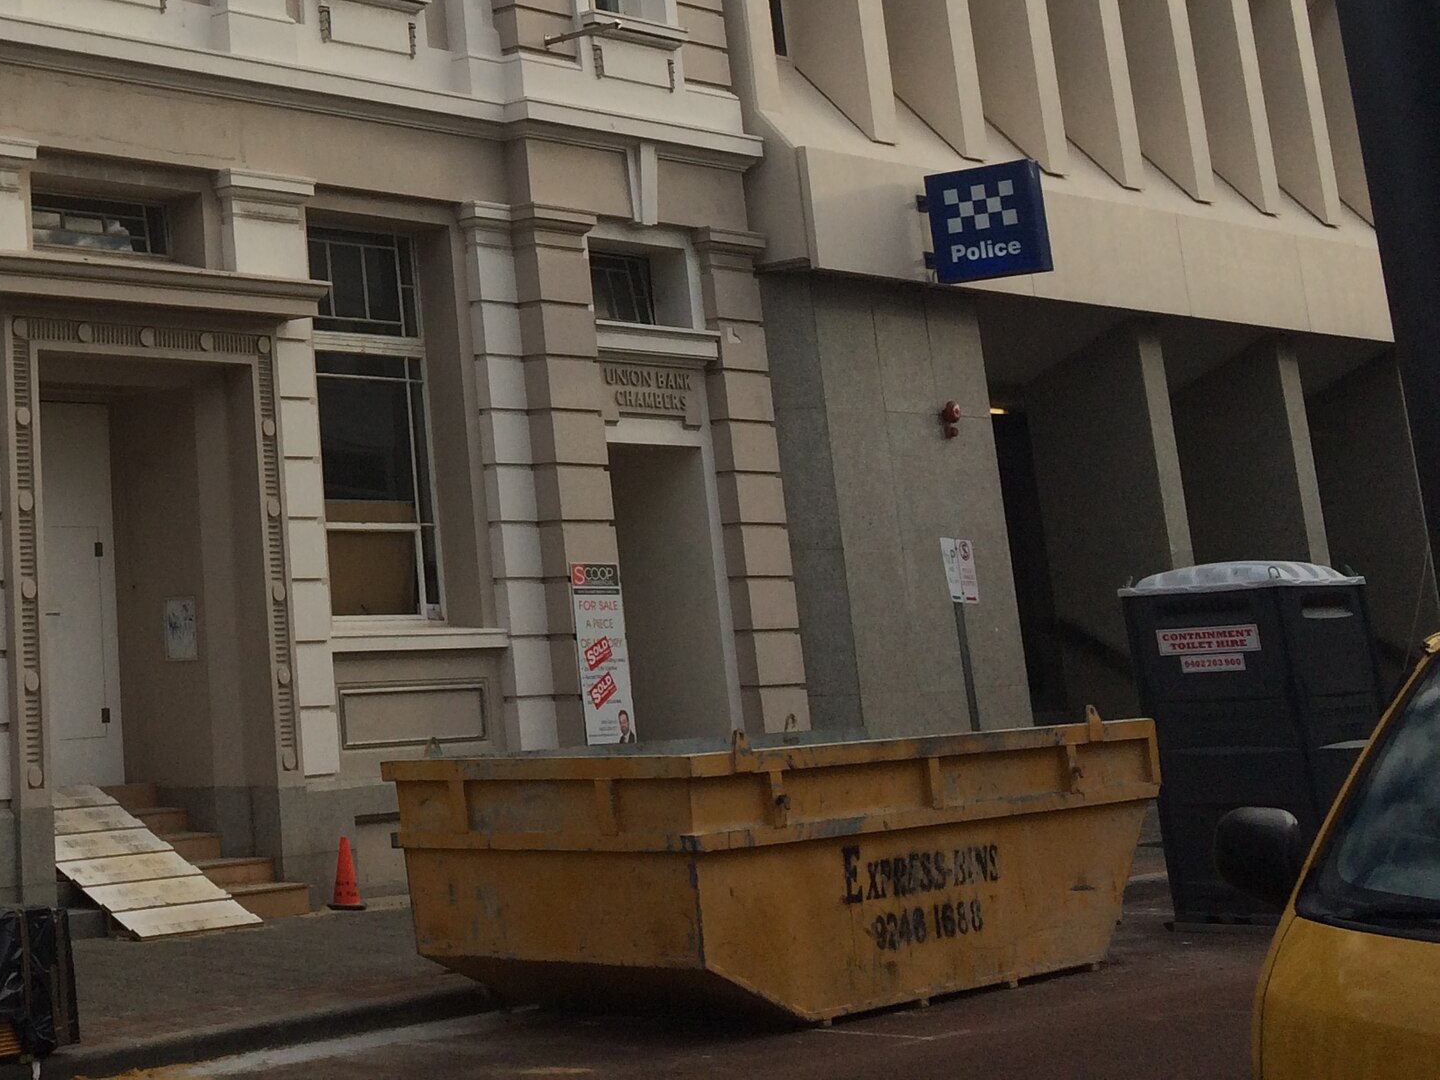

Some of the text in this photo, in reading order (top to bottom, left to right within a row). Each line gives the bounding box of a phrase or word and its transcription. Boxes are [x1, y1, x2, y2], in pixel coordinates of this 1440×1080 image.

[950, 240, 1022, 263] Police
[603, 367, 692, 391] UNION BANK
[615, 390, 688, 411] CHAMBERS
[574, 566, 614, 585] SCOOP
[578, 599, 618, 611] FOR SALE
[586, 618, 592, 629] A
[1162, 629, 1253, 641] CONTAINMENT
[1170, 638, 1248, 650] TOILET HIRE
[586, 639, 609, 666] SOLD
[591, 674, 612, 704] SOLD
